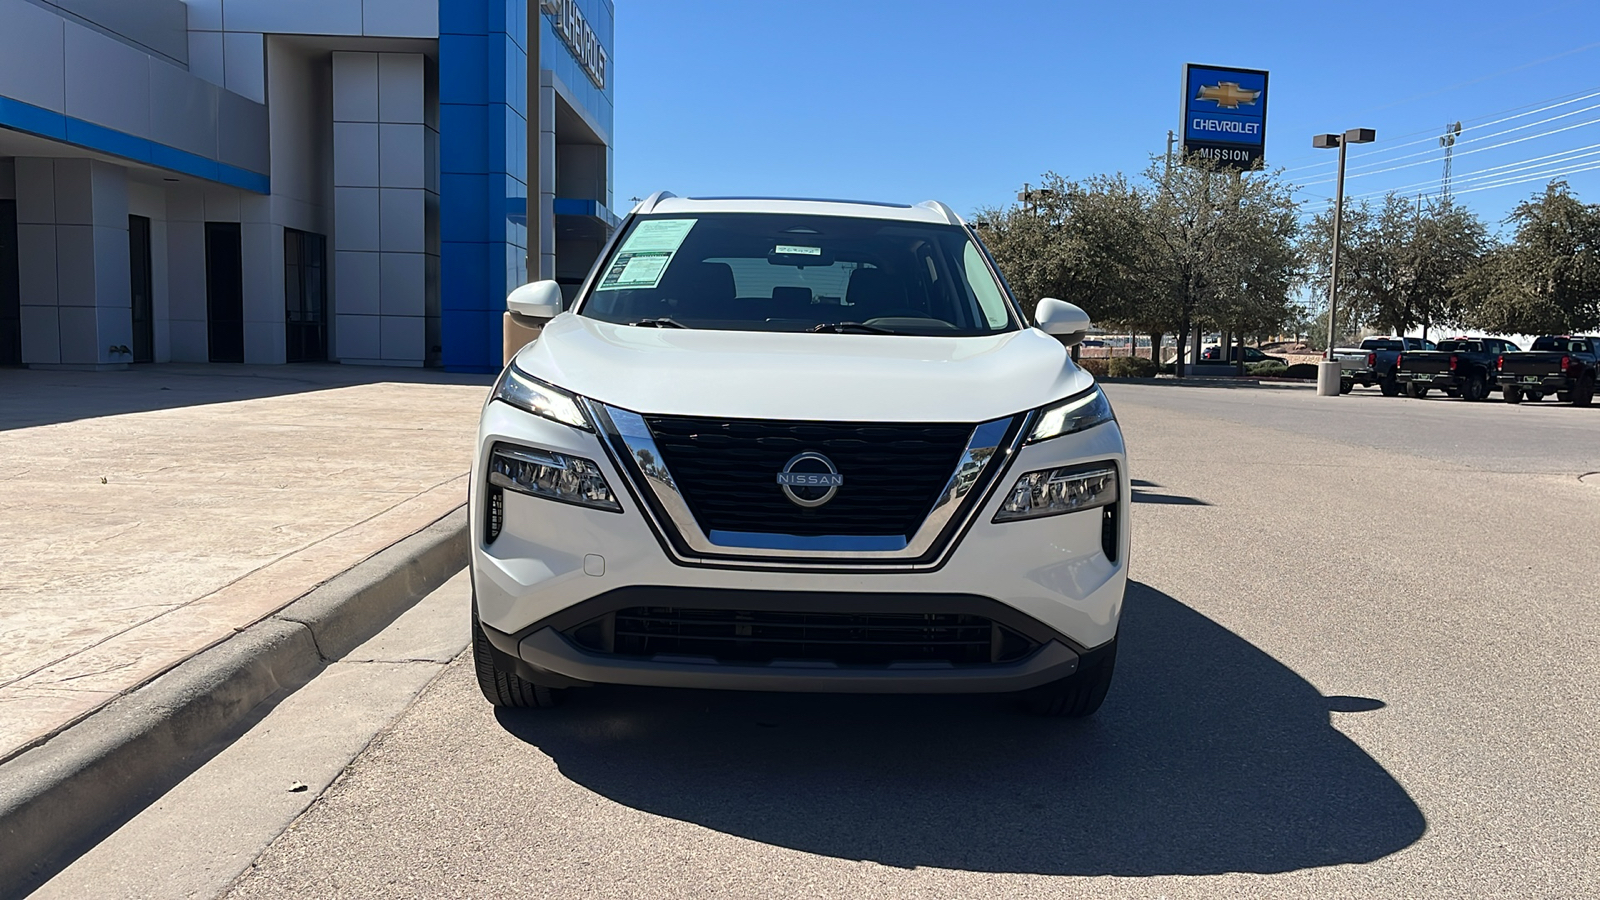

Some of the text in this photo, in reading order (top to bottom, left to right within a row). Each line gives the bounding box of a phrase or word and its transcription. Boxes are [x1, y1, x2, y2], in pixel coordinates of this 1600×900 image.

[562, 0, 607, 90] CHEVROLET
[1193, 118, 1259, 134] CHEVROLET
[1200, 147, 1249, 161] MISSION
[778, 474, 841, 484] NISSAN
